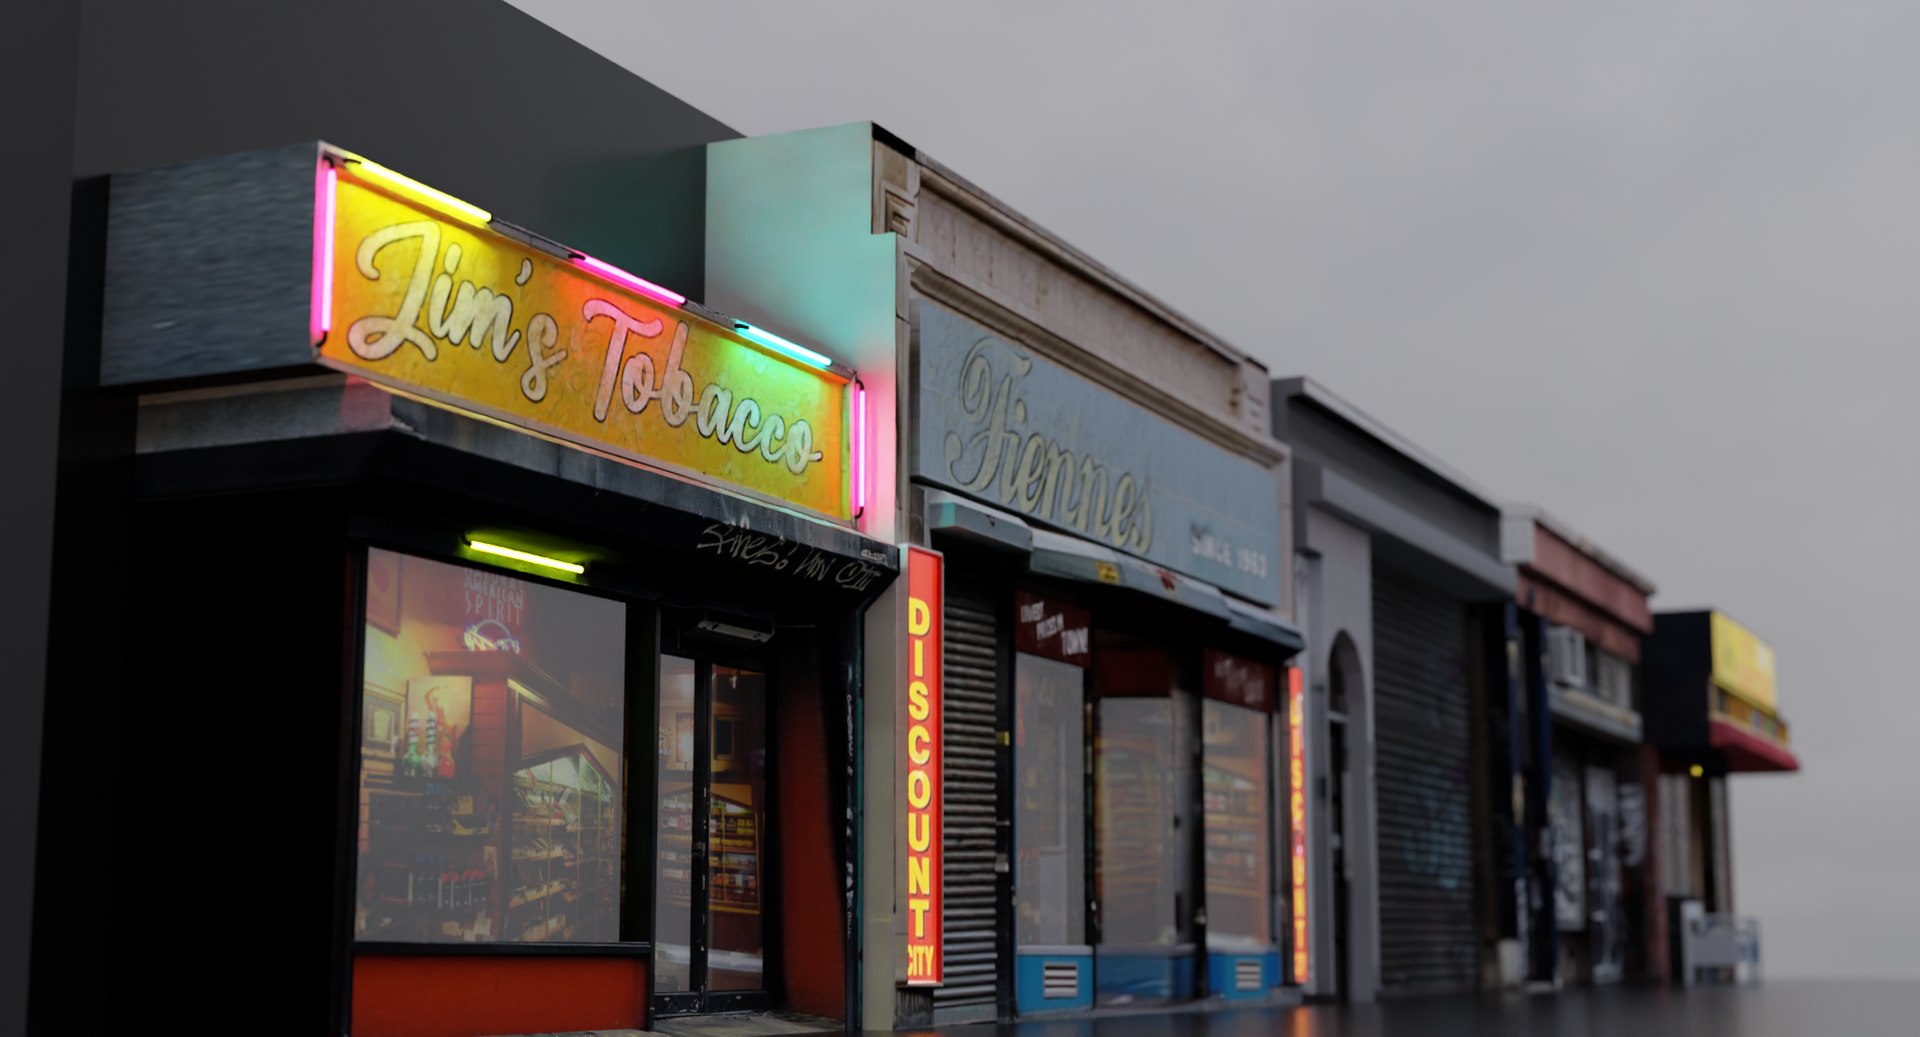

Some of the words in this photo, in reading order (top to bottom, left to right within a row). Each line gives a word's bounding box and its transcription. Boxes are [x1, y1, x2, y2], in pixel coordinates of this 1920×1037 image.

[347, 220, 567, 402] Jim's
[582, 298, 822, 475] Tobacco
[944, 336, 1153, 556] Fiennes
[465, 591, 521, 625] SPIRIT
[908, 597, 932, 939] DISCOUNT
[908, 944, 934, 976] CITY
